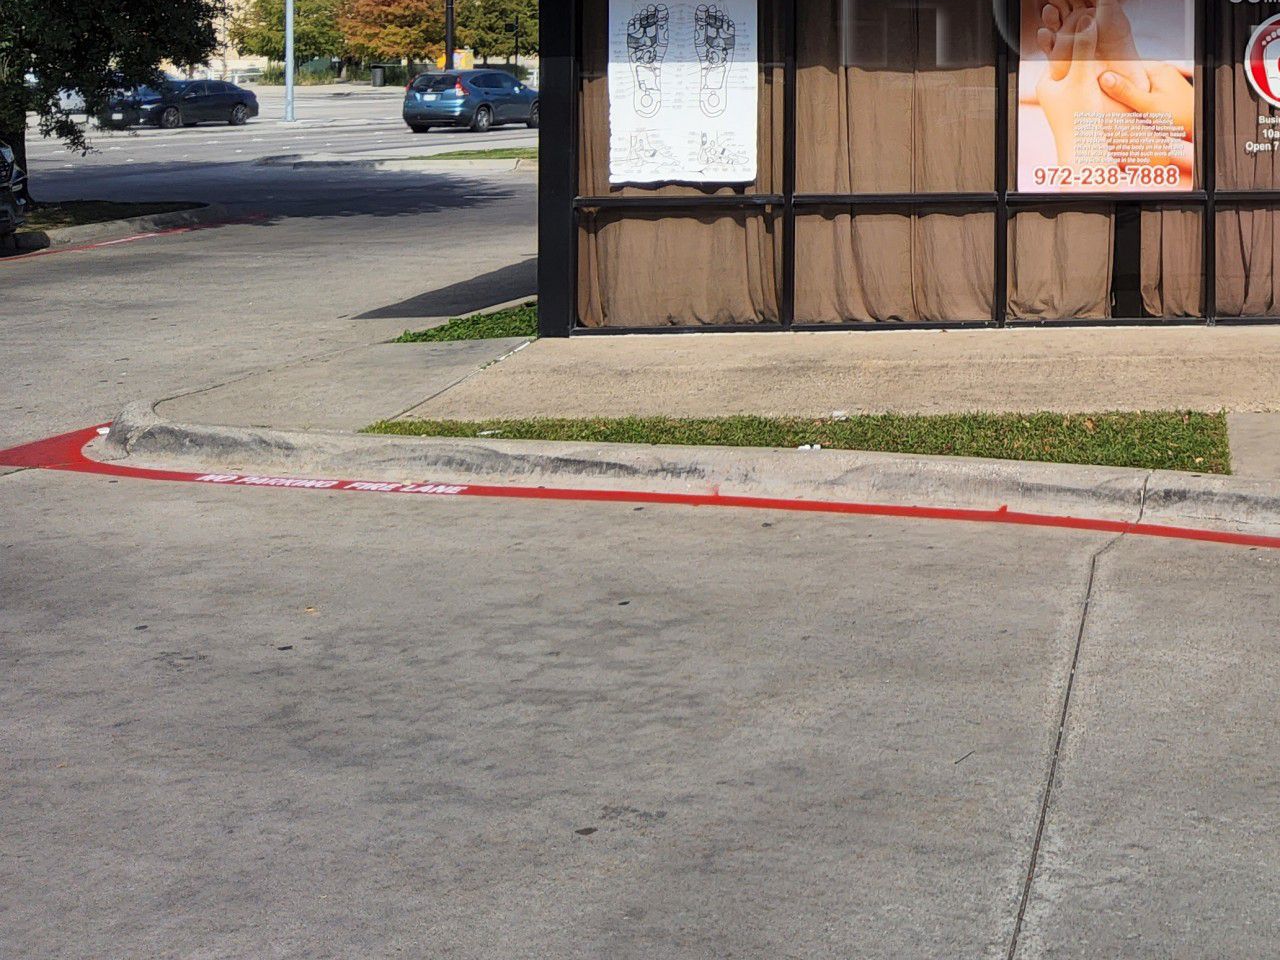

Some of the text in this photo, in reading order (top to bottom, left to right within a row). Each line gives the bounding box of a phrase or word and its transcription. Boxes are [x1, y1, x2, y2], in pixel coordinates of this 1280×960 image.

[1245, 141, 1272, 152] Open
[1273, 141, 1279, 150] 7
[1033, 166, 1179, 186] 972-238-7888
[196, 473, 469, 495] NO PARKING FIRE LANE
